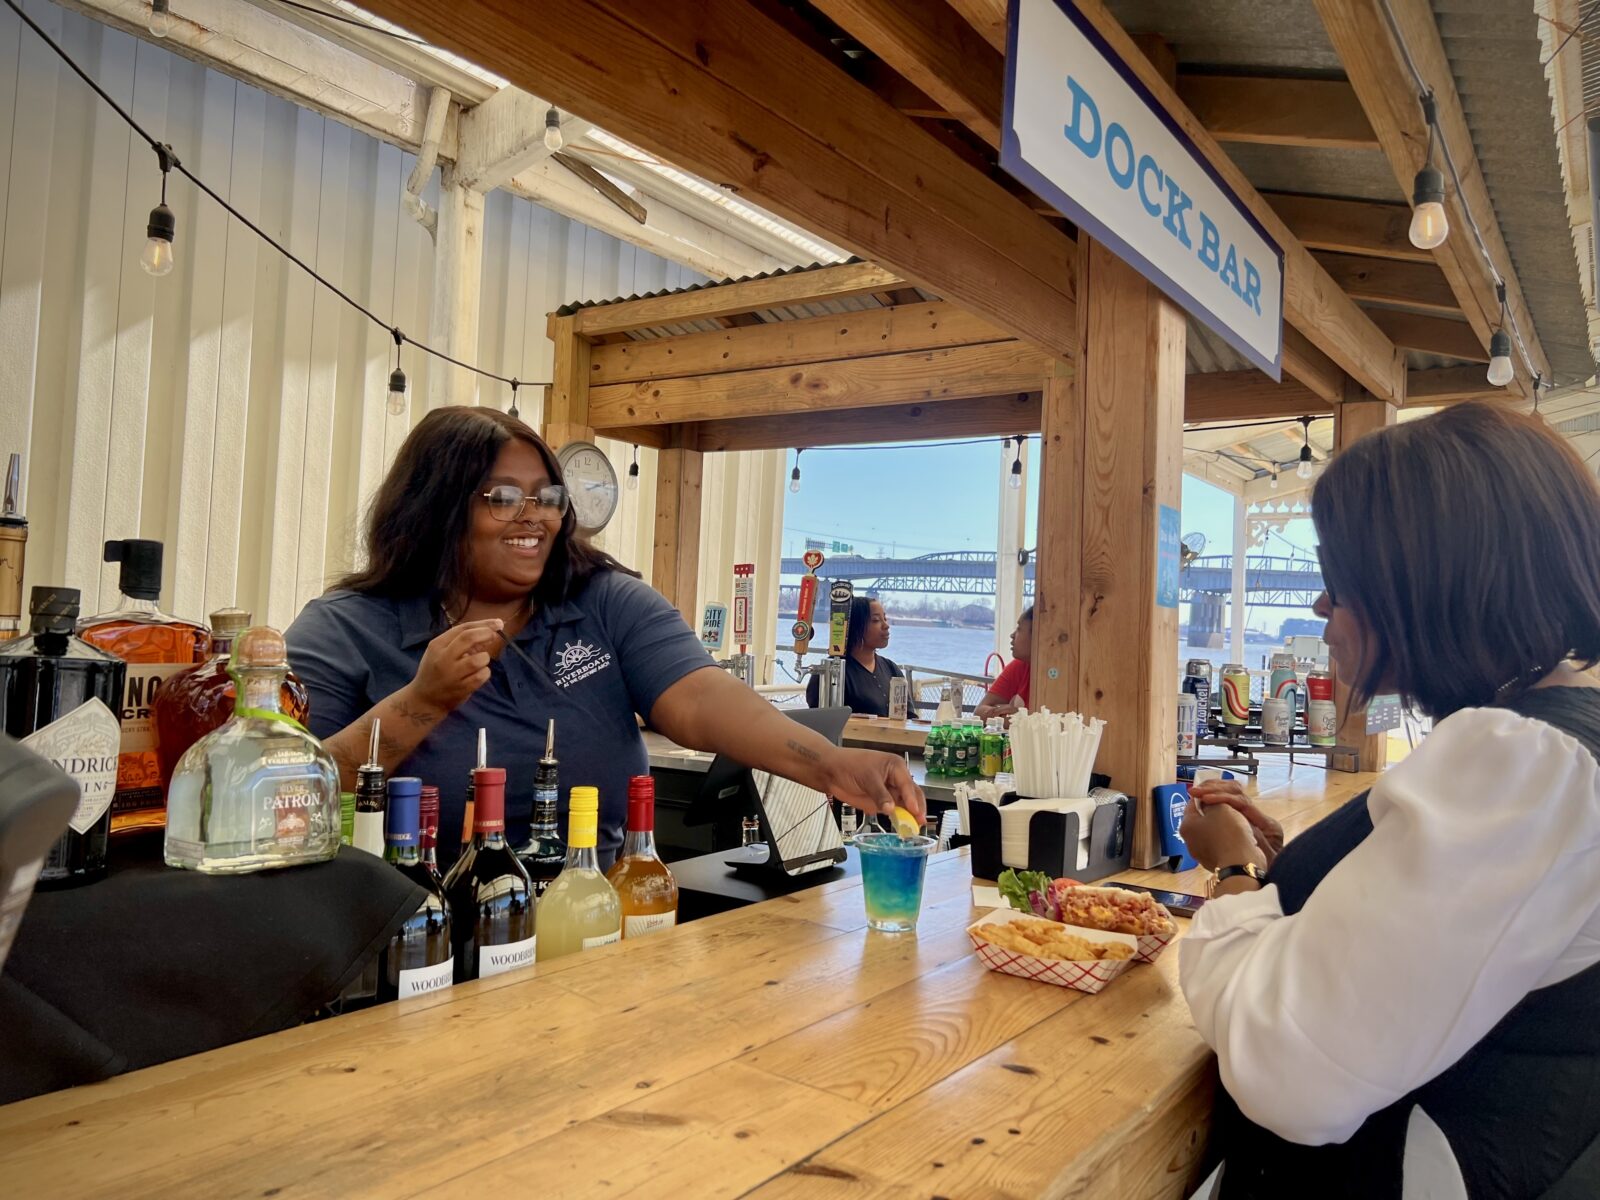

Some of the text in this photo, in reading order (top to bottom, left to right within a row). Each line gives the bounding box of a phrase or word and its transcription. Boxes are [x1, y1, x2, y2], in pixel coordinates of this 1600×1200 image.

[1063, 74, 1262, 317] DOCK BAR
[704, 609, 722, 620] CITY
[554, 653, 611, 686] RIVERBOATS
[1177, 705, 1195, 721] ITY
